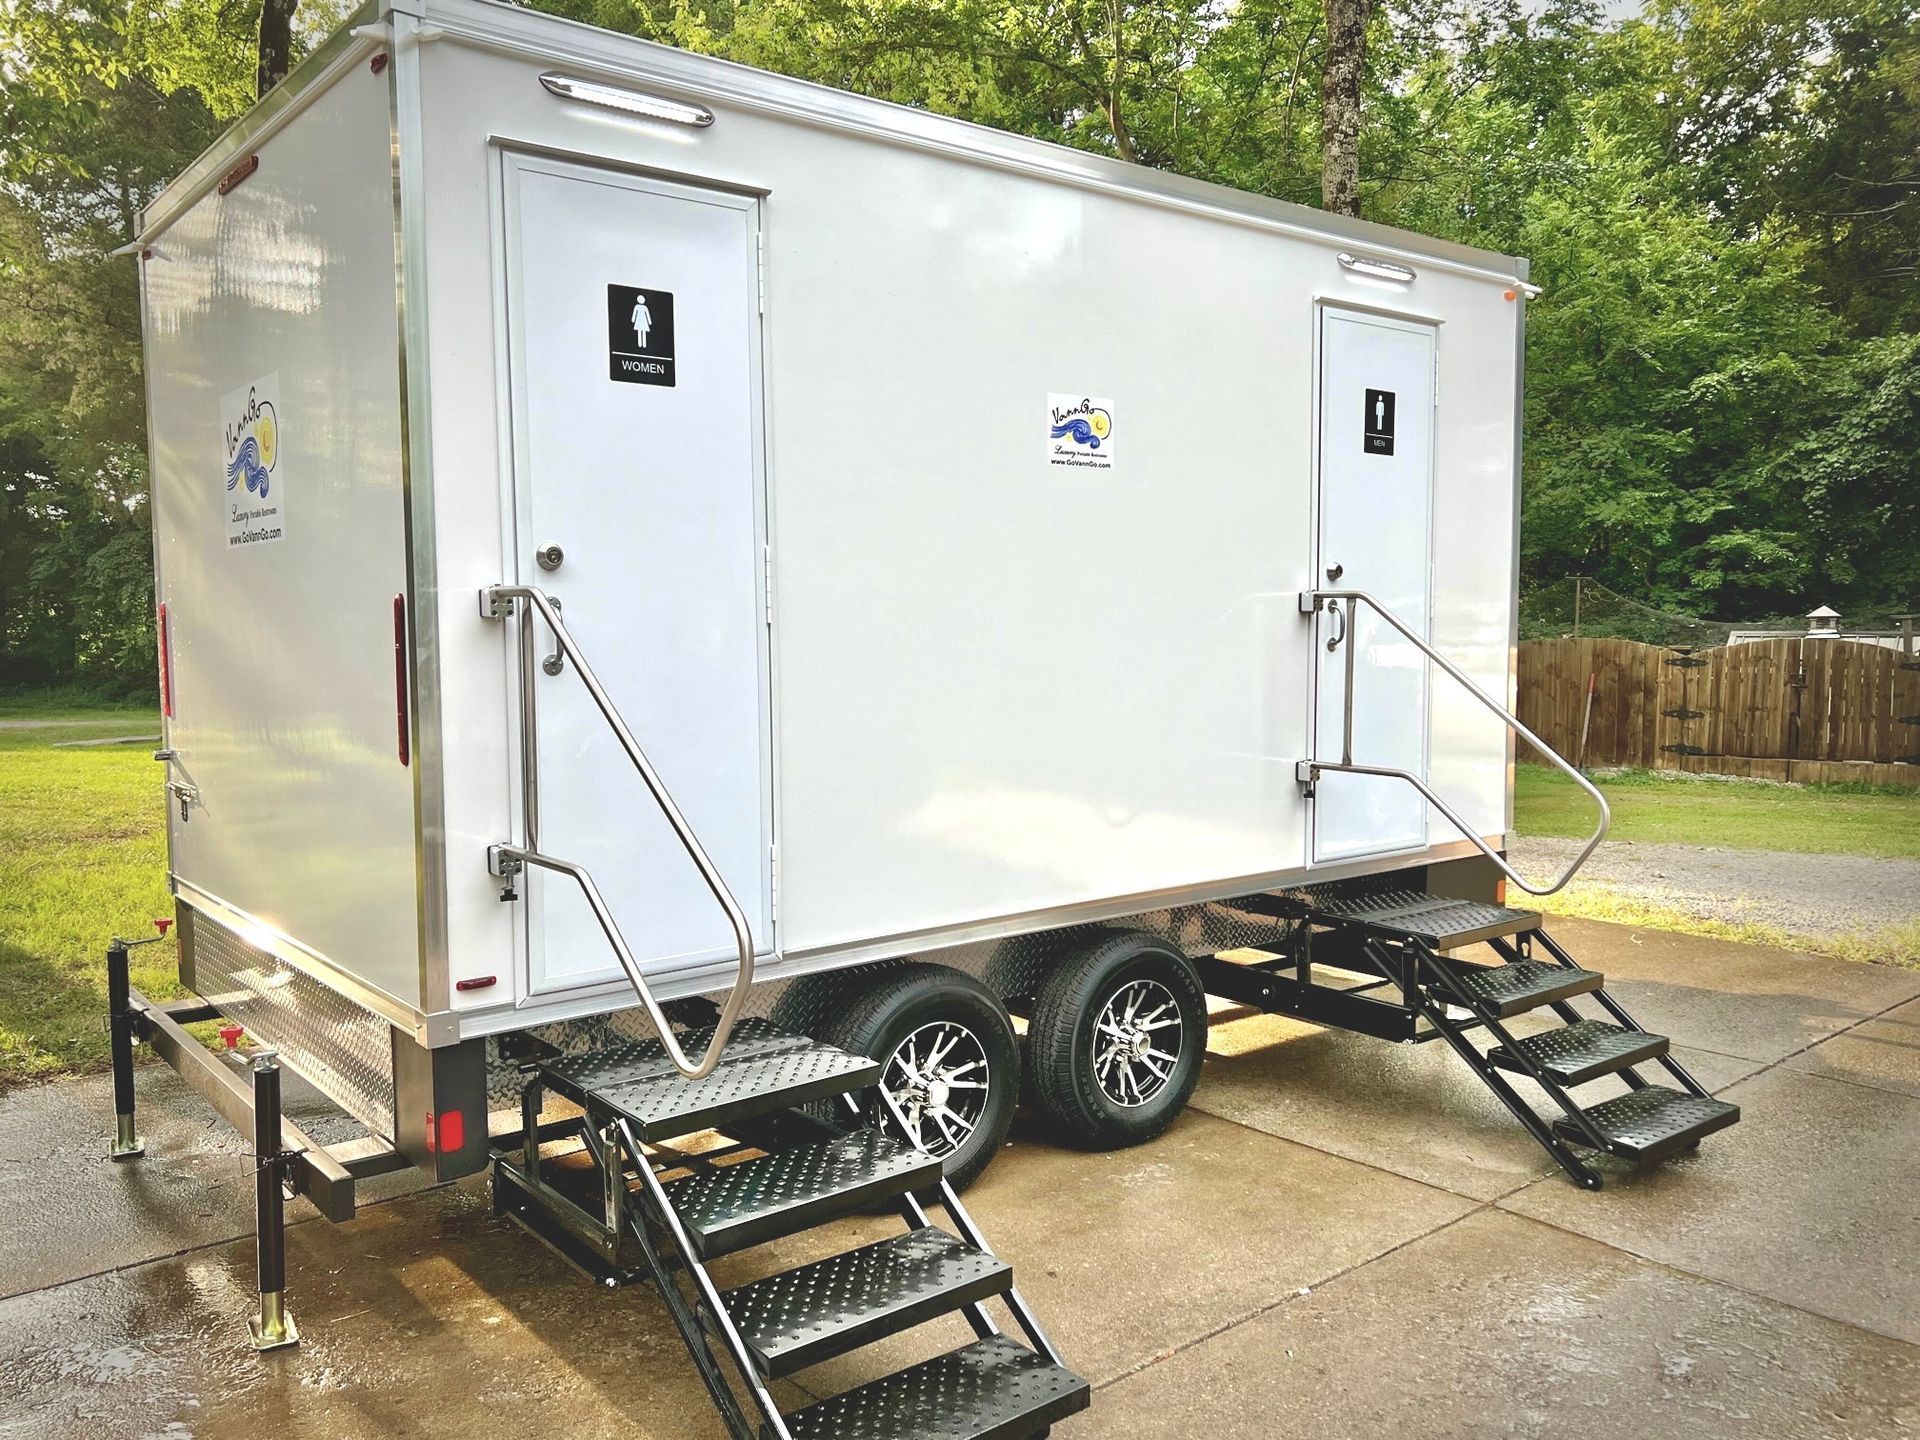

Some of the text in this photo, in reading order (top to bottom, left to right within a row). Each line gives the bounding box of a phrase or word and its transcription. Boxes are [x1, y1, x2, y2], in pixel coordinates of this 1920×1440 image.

[621, 359, 665, 374] WOMEN
[1052, 398, 1095, 424] VannGo
[1373, 439, 1386, 447] MEN
[1051, 459, 1111, 469] www.GoVannGo.com
[230, 528, 282, 546] www.GoVannGo.com
